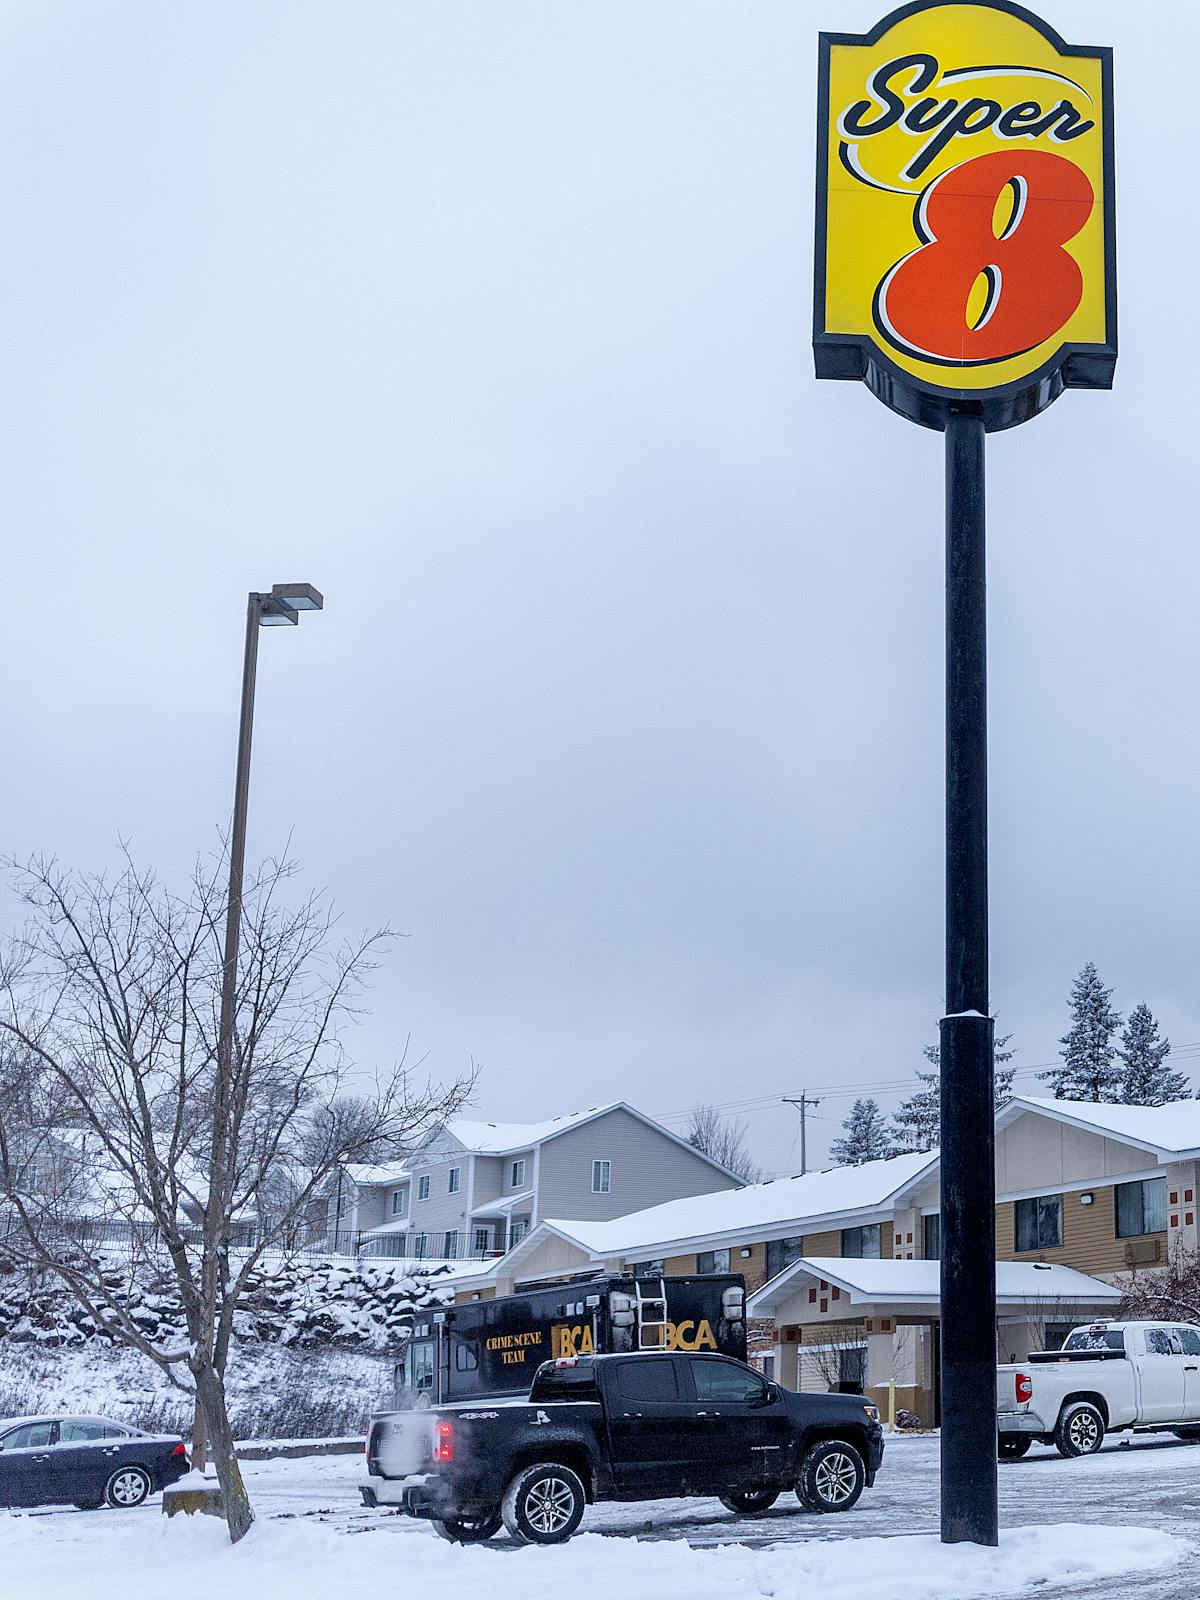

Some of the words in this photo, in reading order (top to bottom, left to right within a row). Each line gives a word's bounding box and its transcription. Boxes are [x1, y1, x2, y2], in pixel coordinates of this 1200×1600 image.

[838, 53, 1095, 181] Super
[872, 149, 1094, 367] 8
[486, 1335, 513, 1351] CRIME
[515, 1331, 542, 1347] SCENE
[560, 1325, 594, 1358] BCA
[659, 1319, 718, 1351] BCA
[501, 1350, 525, 1365] TEAM
